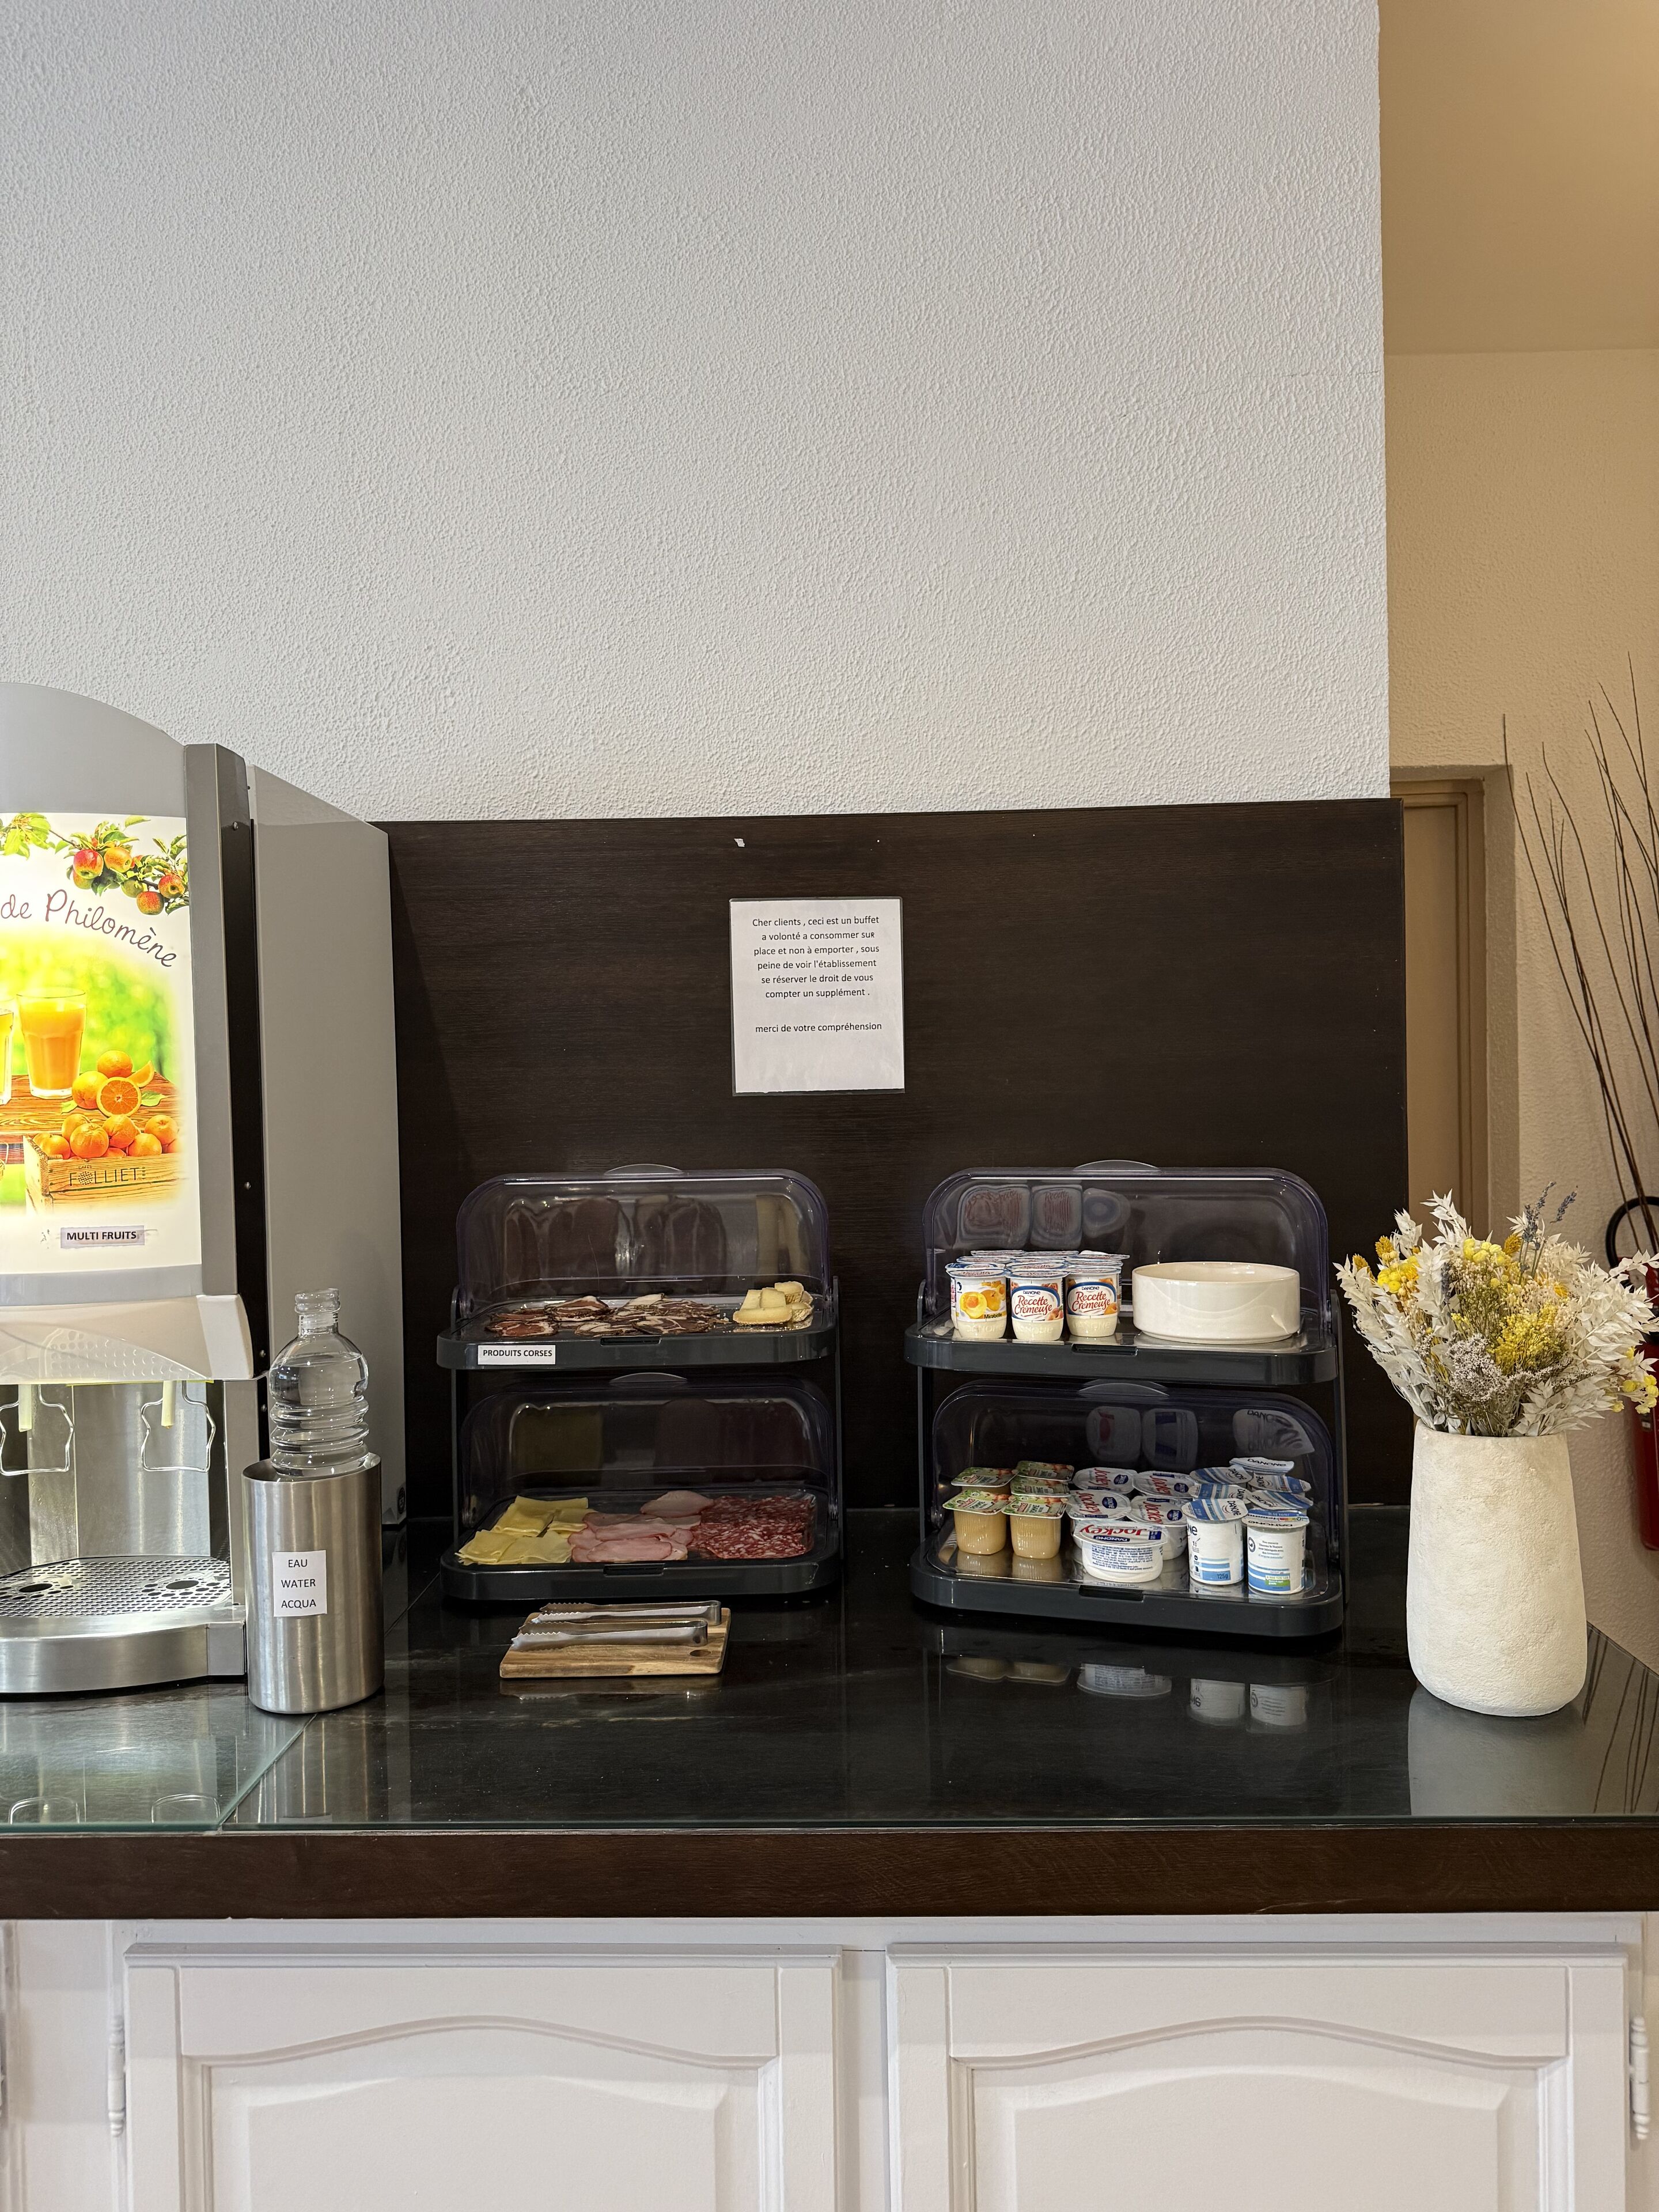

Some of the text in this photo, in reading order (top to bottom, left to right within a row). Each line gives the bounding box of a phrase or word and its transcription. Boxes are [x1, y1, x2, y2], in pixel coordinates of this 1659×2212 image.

[752, 918, 772, 927] Cher
[774, 918, 801, 926] clients
[808, 917, 824, 925] ceci
[854, 915, 879, 924] buffet
[1, 889, 176, 967] de Philomène
[768, 931, 801, 941] volonté
[753, 947, 776, 957] place
[807, 946, 812, 954] à
[814, 946, 854, 955] emporter
[757, 960, 877, 971] peine de voir l'établissement
[772, 975, 807, 983] réserver
[809, 975, 817, 983] le
[819, 974, 839, 982] droit
[841, 974, 852, 982] de
[766, 990, 801, 999] compter
[816, 988, 865, 998] supplément
[755, 1024, 778, 1033] merci
[781, 1024, 791, 1032] de
[817, 1022, 882, 1032] compréhension
[67, 1231, 137, 1240] MULTI FRUITS
[1018, 1296, 1048, 1306] Recette
[1075, 1291, 1107, 1302] Recette
[1075, 1491, 1103, 1514] Jockey
[1080, 1524, 1147, 1536] Jockey
[288, 1559, 308, 1567] EAU
[281, 1578, 316, 1588] WATER
[281, 1599, 316, 1609] ACQUA
